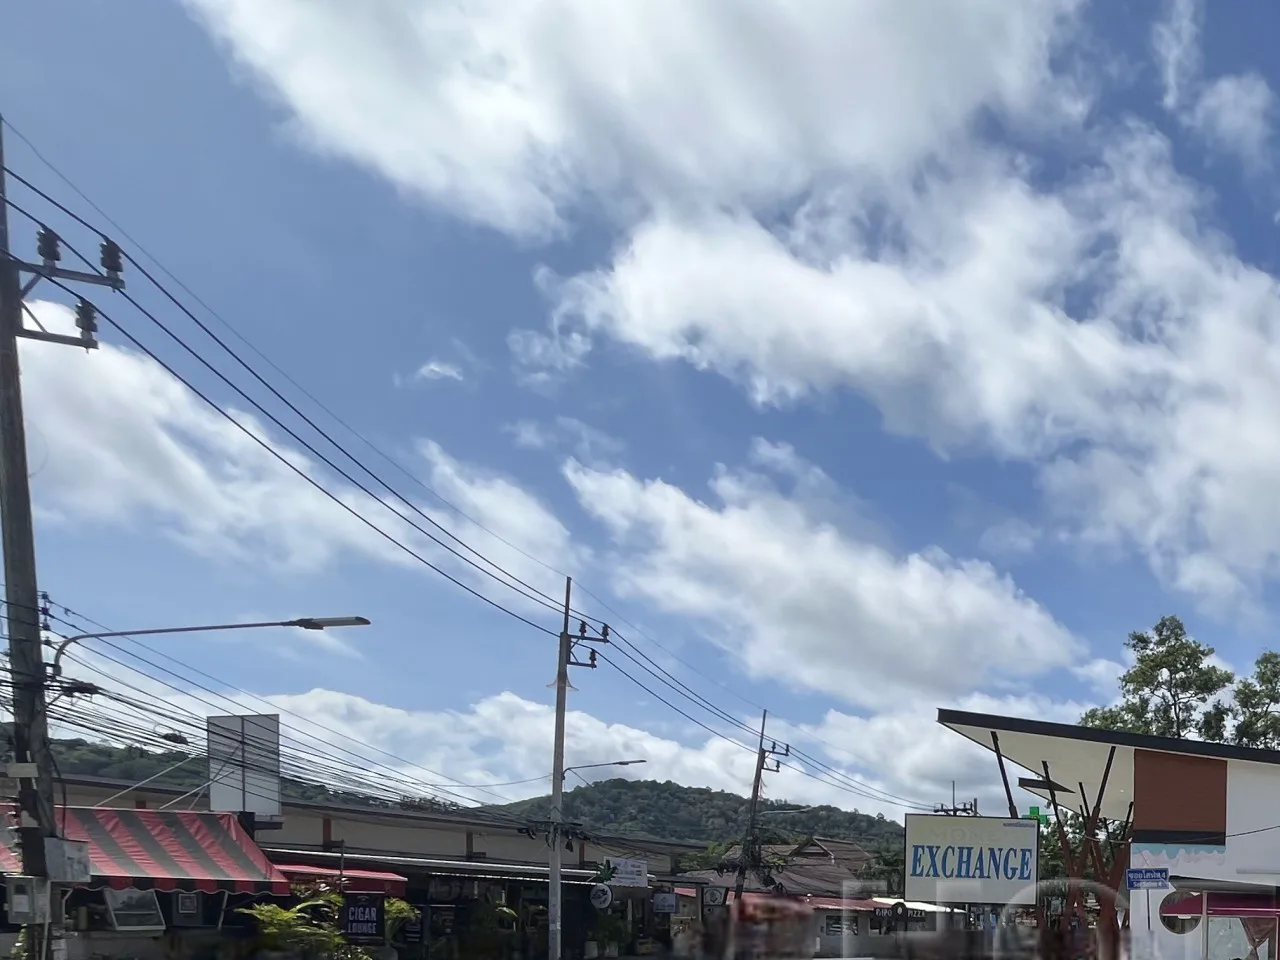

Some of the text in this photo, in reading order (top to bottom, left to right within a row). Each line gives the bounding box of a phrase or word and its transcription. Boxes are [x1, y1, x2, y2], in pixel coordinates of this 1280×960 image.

[910, 844, 1033, 881] EXCHANGE
[348, 906, 377, 921] CIGAR
[907, 909, 925, 918] PIZZA
[347, 922, 377, 934] LOUNGE
